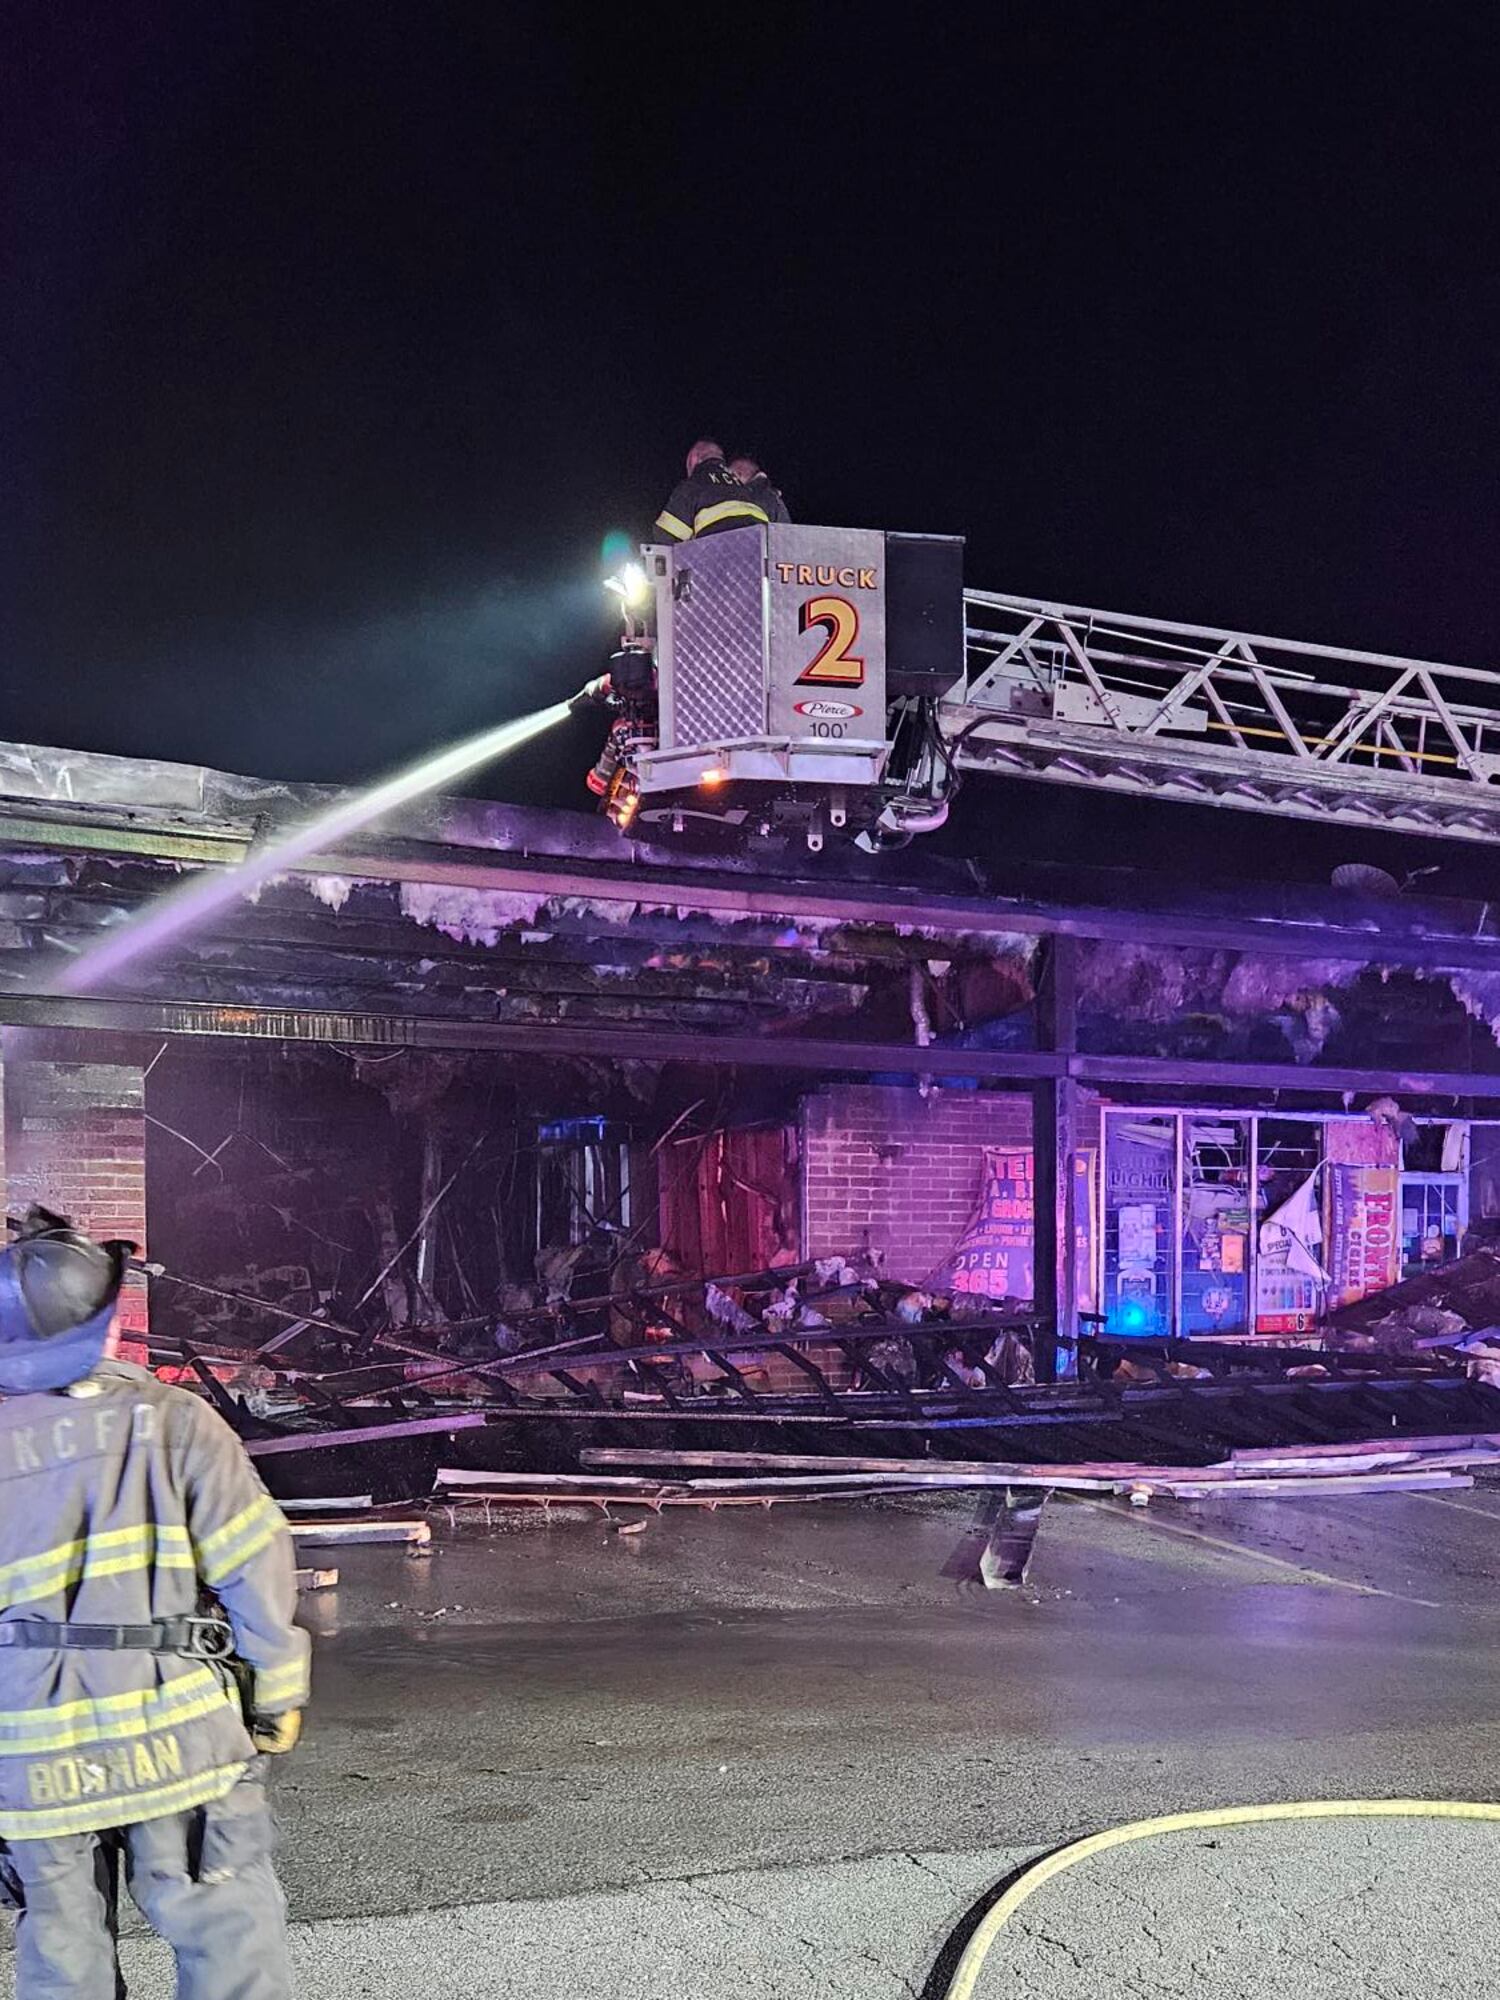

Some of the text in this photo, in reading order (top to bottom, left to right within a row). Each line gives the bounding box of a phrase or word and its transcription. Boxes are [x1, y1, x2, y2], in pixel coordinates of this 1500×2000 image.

[776, 563, 877, 589] TRUCK
[793, 597, 865, 689] 2
[809, 703, 847, 715] Pierce
[955, 1252, 1009, 1270] OPEN
[952, 1269, 1009, 1296] 365
[1297, 1312, 1304, 1331] 6
[12, 1403, 155, 1471] KCFD
